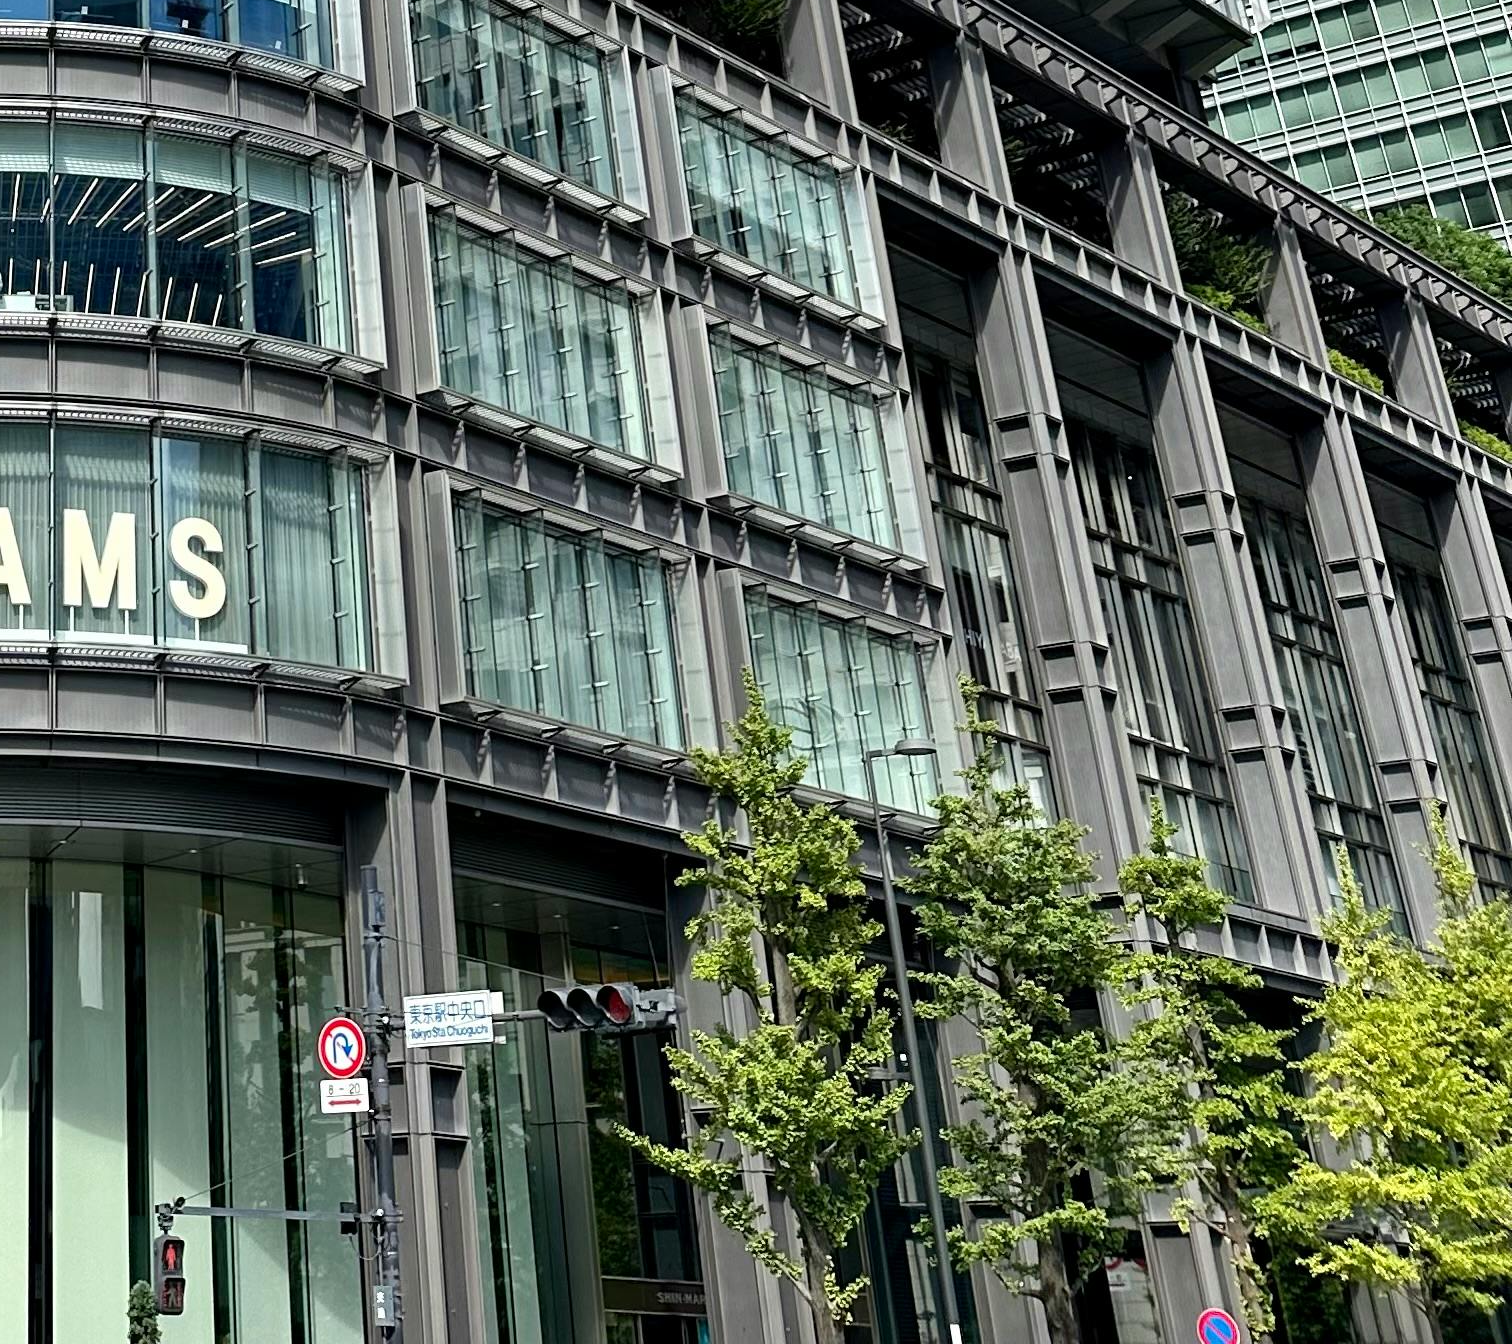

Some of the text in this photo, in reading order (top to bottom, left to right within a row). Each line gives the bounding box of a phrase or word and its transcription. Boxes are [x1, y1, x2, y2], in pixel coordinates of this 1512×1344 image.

[409, 999, 486, 1025] 東京駅中央口
[409, 1027, 431, 1041] Tokyo
[348, 1082, 361, 1095] 20
